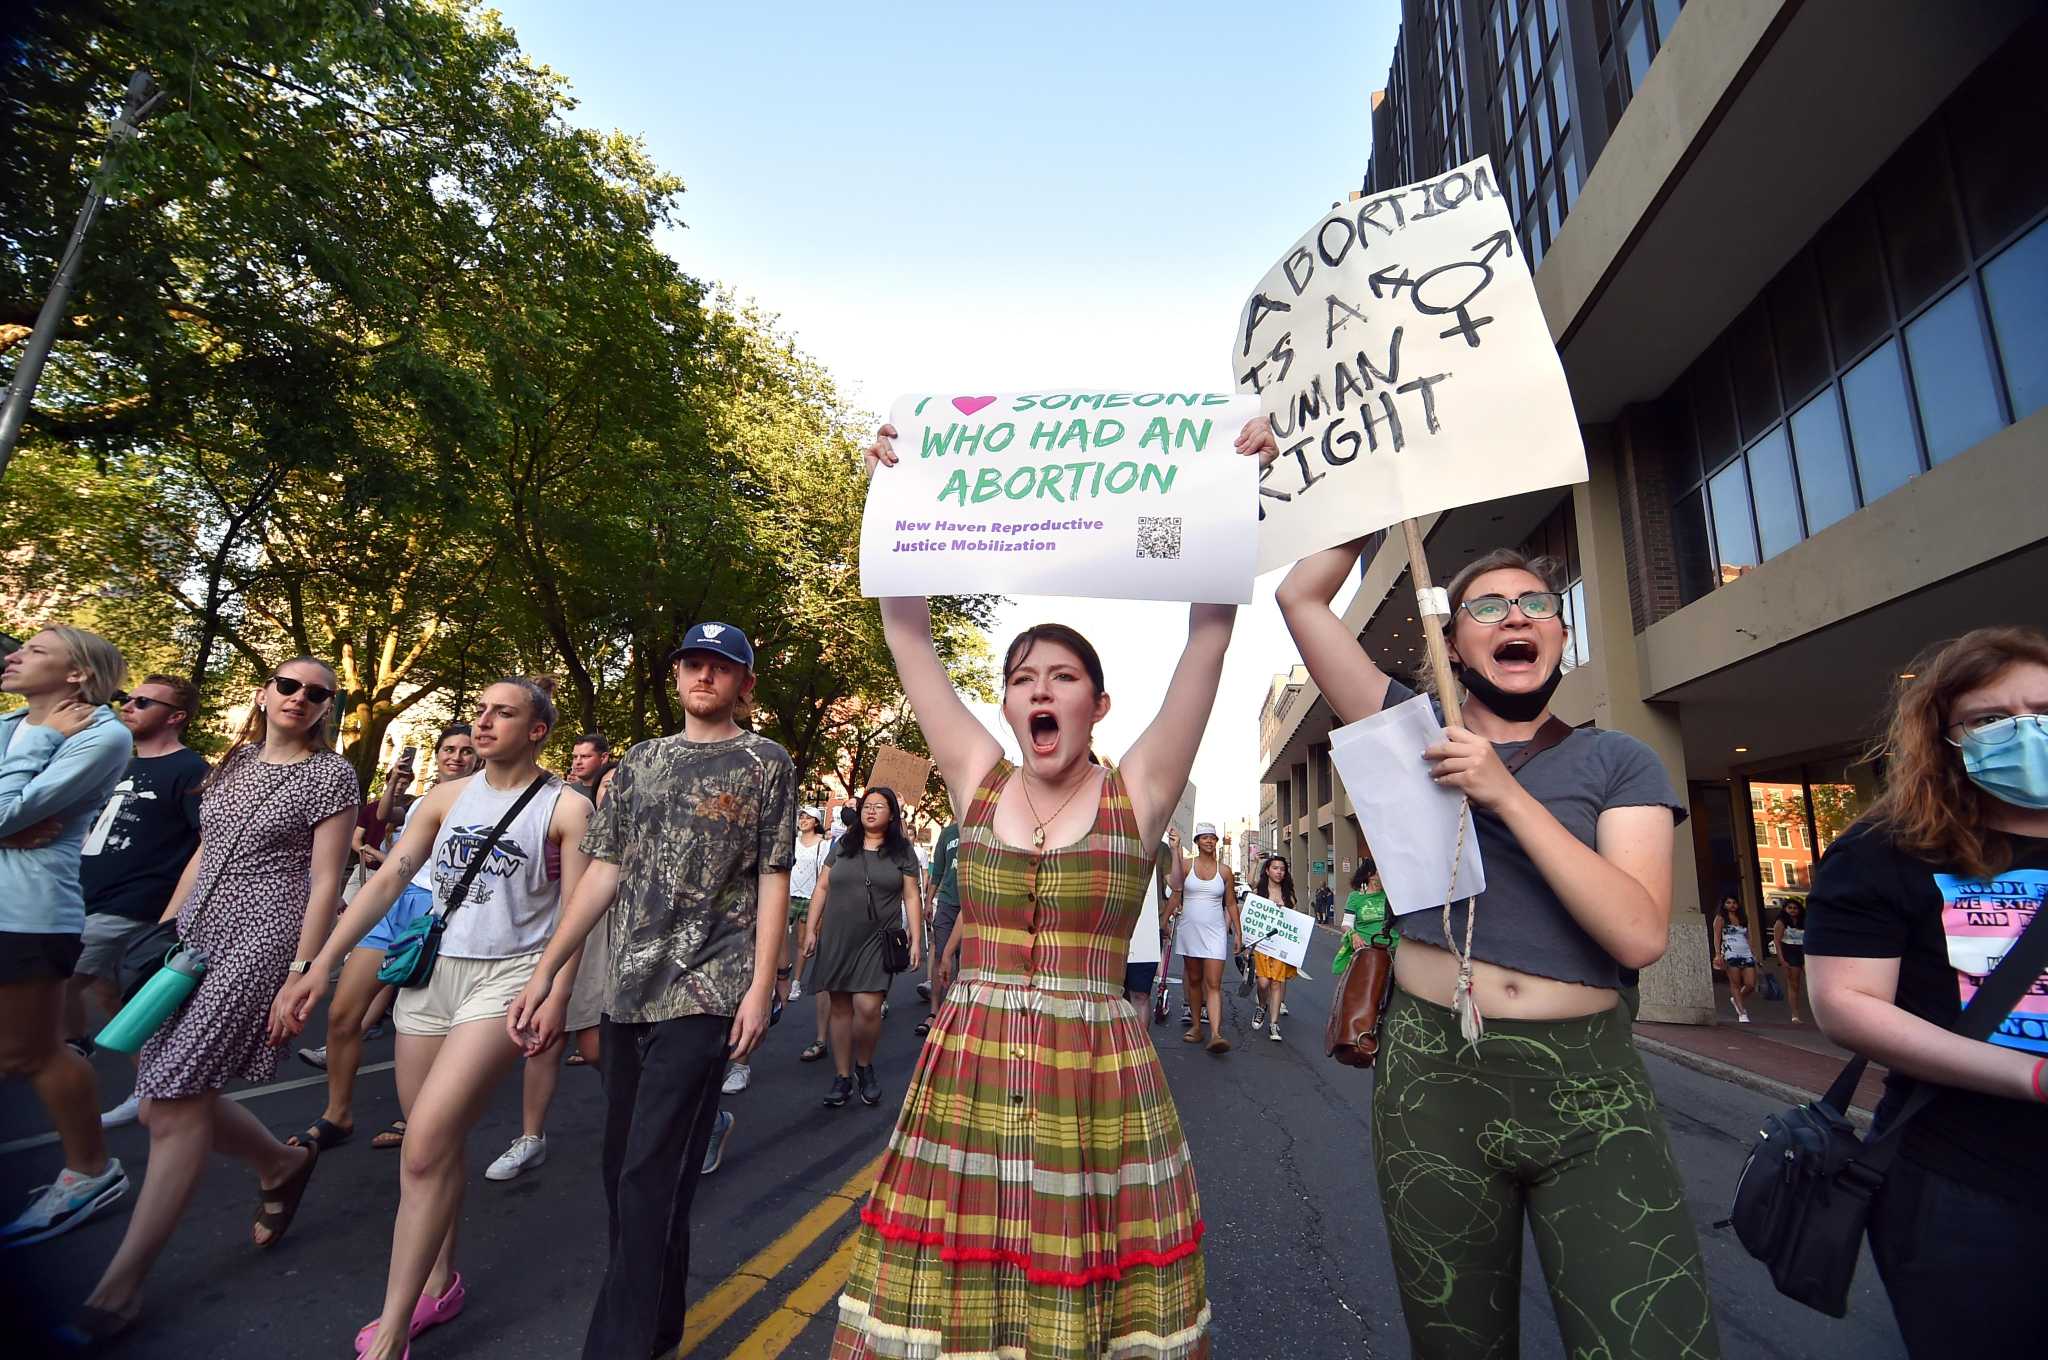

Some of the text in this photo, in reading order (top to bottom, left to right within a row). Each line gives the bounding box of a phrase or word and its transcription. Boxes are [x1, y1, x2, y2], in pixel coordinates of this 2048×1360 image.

[1244, 166, 1501, 356] ABORTION
[1240, 294, 1369, 394] IS A
[1269, 326, 1404, 438] UMAN
[914, 393, 1230, 416] I SOMEONE
[920, 416, 1213, 458] WHO HAD AN
[1259, 371, 1454, 521] RIGHT
[937, 461, 1179, 507] ABORTION
[895, 518, 1104, 535] New Haven Reproductive
[892, 539, 1056, 552] Justice Mobilization
[1250, 900, 1285, 918] COURTS
[1955, 898, 2042, 910] WE EXTEN
[1245, 917, 1264, 929] OUR
[1247, 908, 1299, 933] DON'T RULE
[1969, 912, 2009, 925] AND
[1243, 925, 1256, 936] WE
